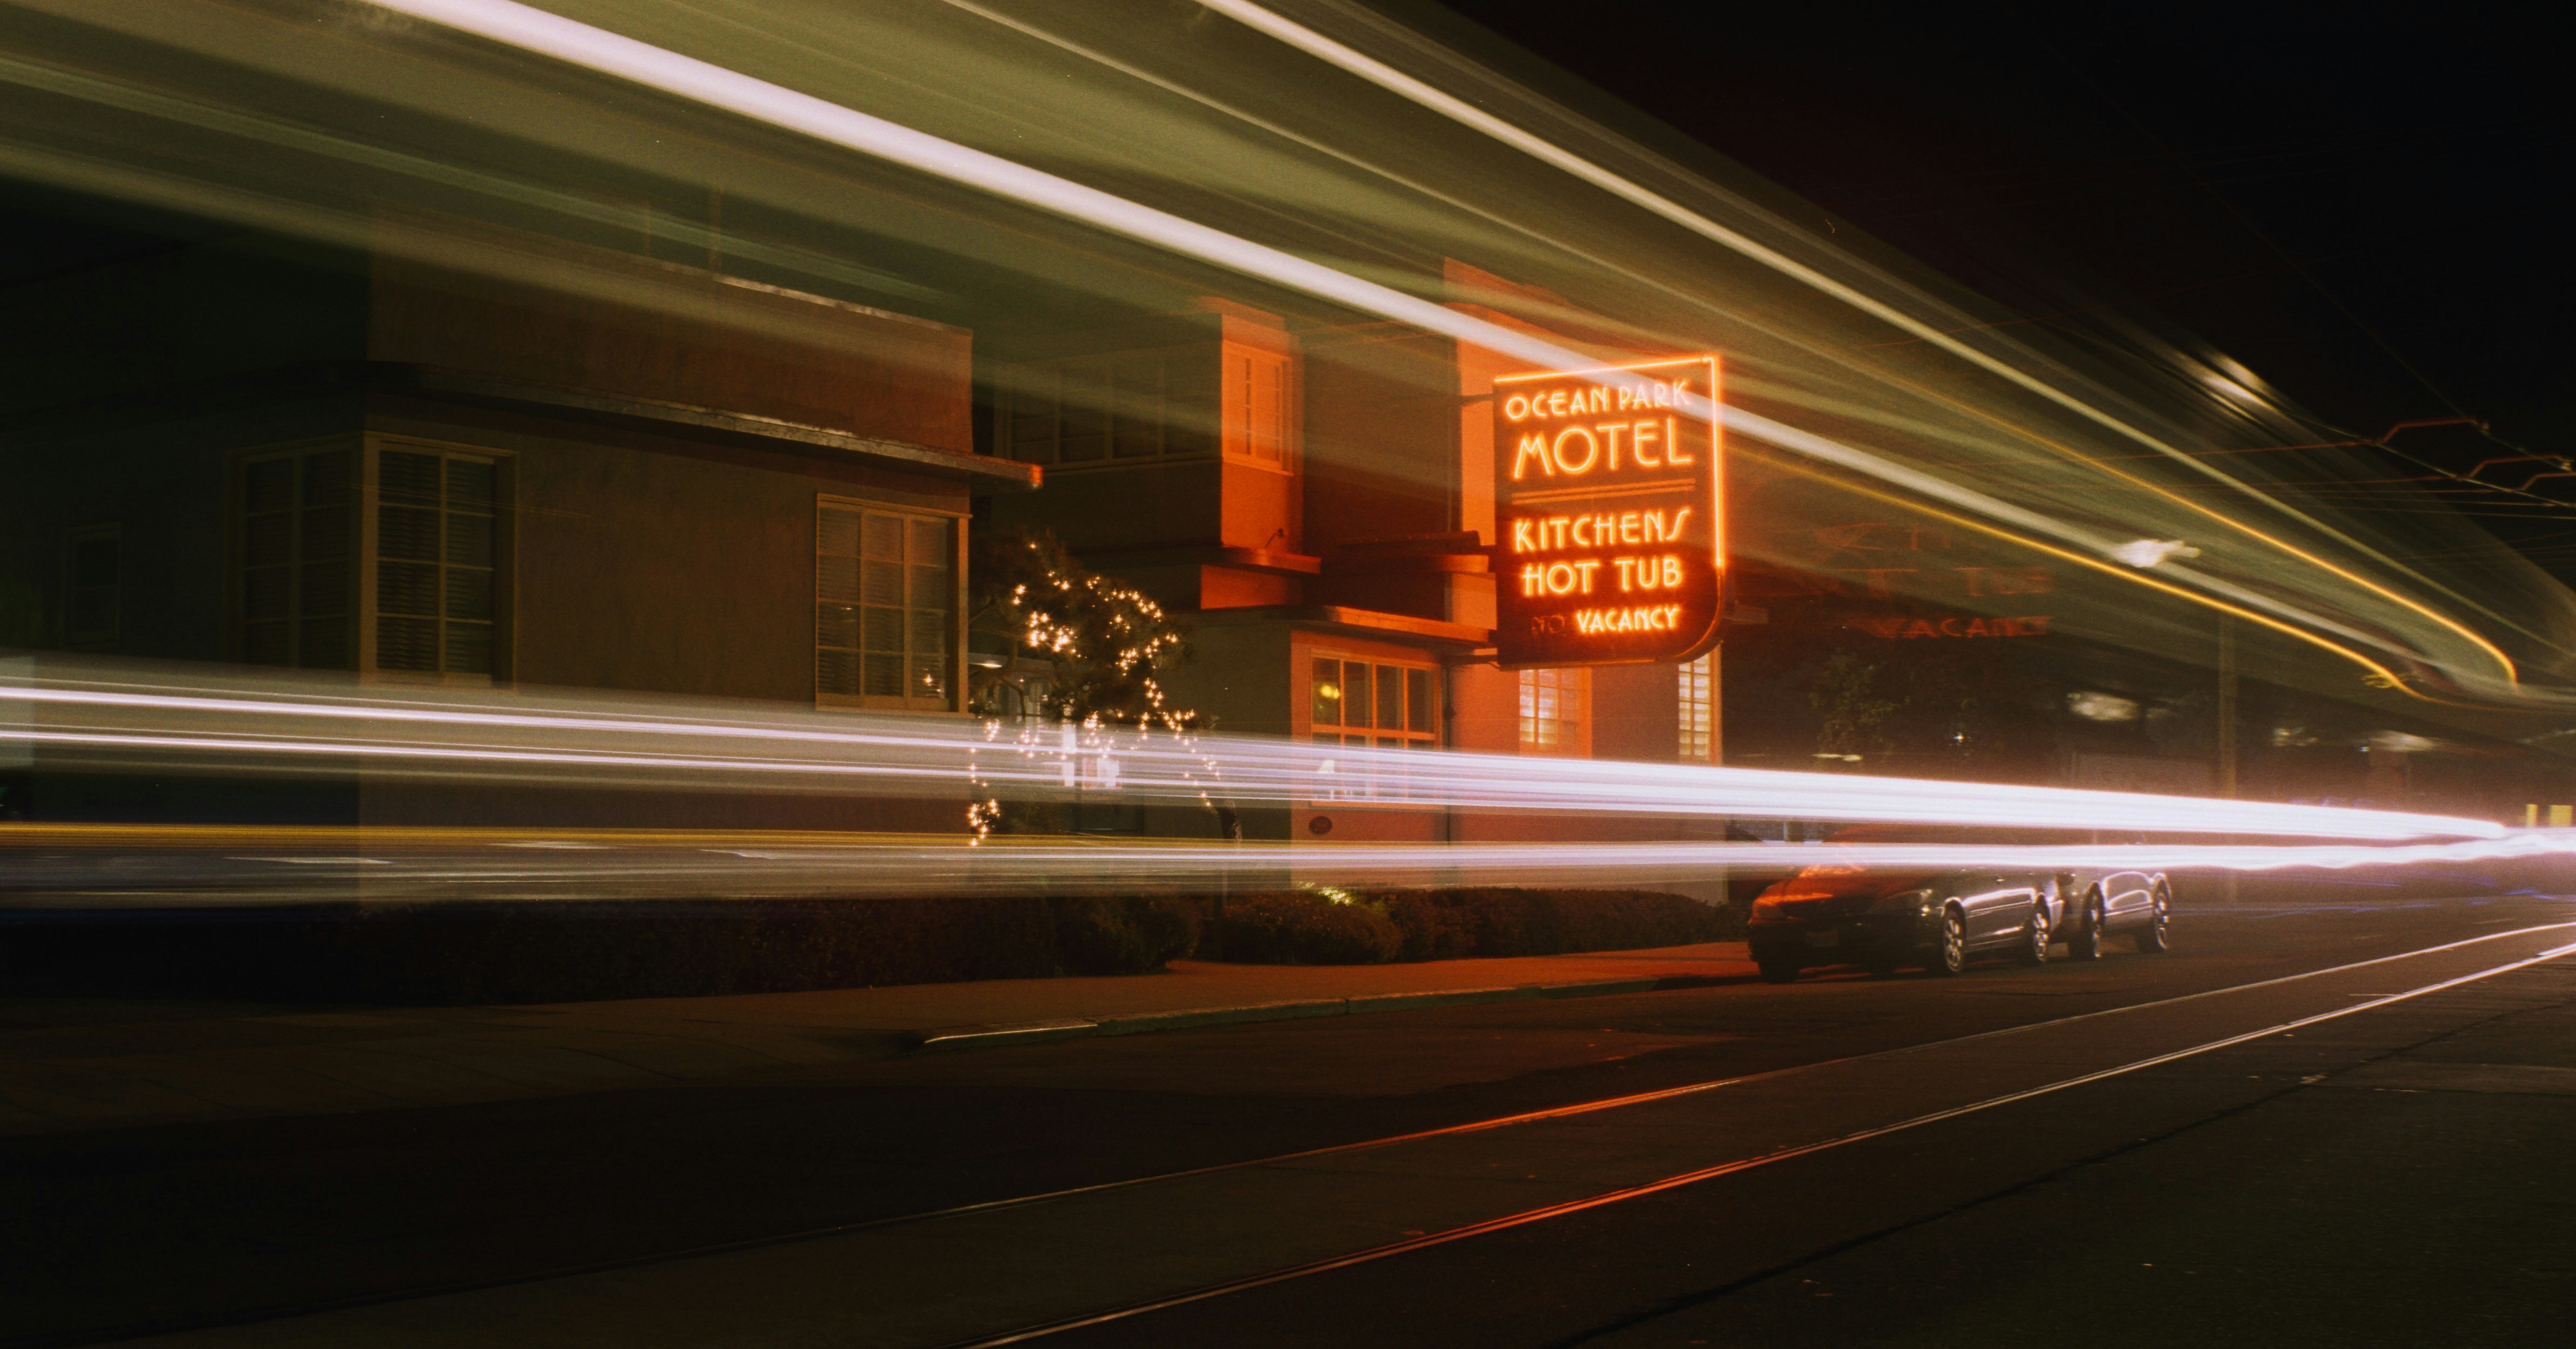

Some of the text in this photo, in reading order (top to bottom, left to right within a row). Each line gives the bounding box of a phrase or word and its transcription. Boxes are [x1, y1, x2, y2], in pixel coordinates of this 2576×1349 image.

[1506, 381, 1691, 420] OCEAN PARK
[1512, 417, 1692, 479] MOTEL
[1513, 508, 1692, 551] KITCHENS
[1522, 556, 1683, 596] HOT TUB
[1575, 605, 1680, 635] VACANCY
